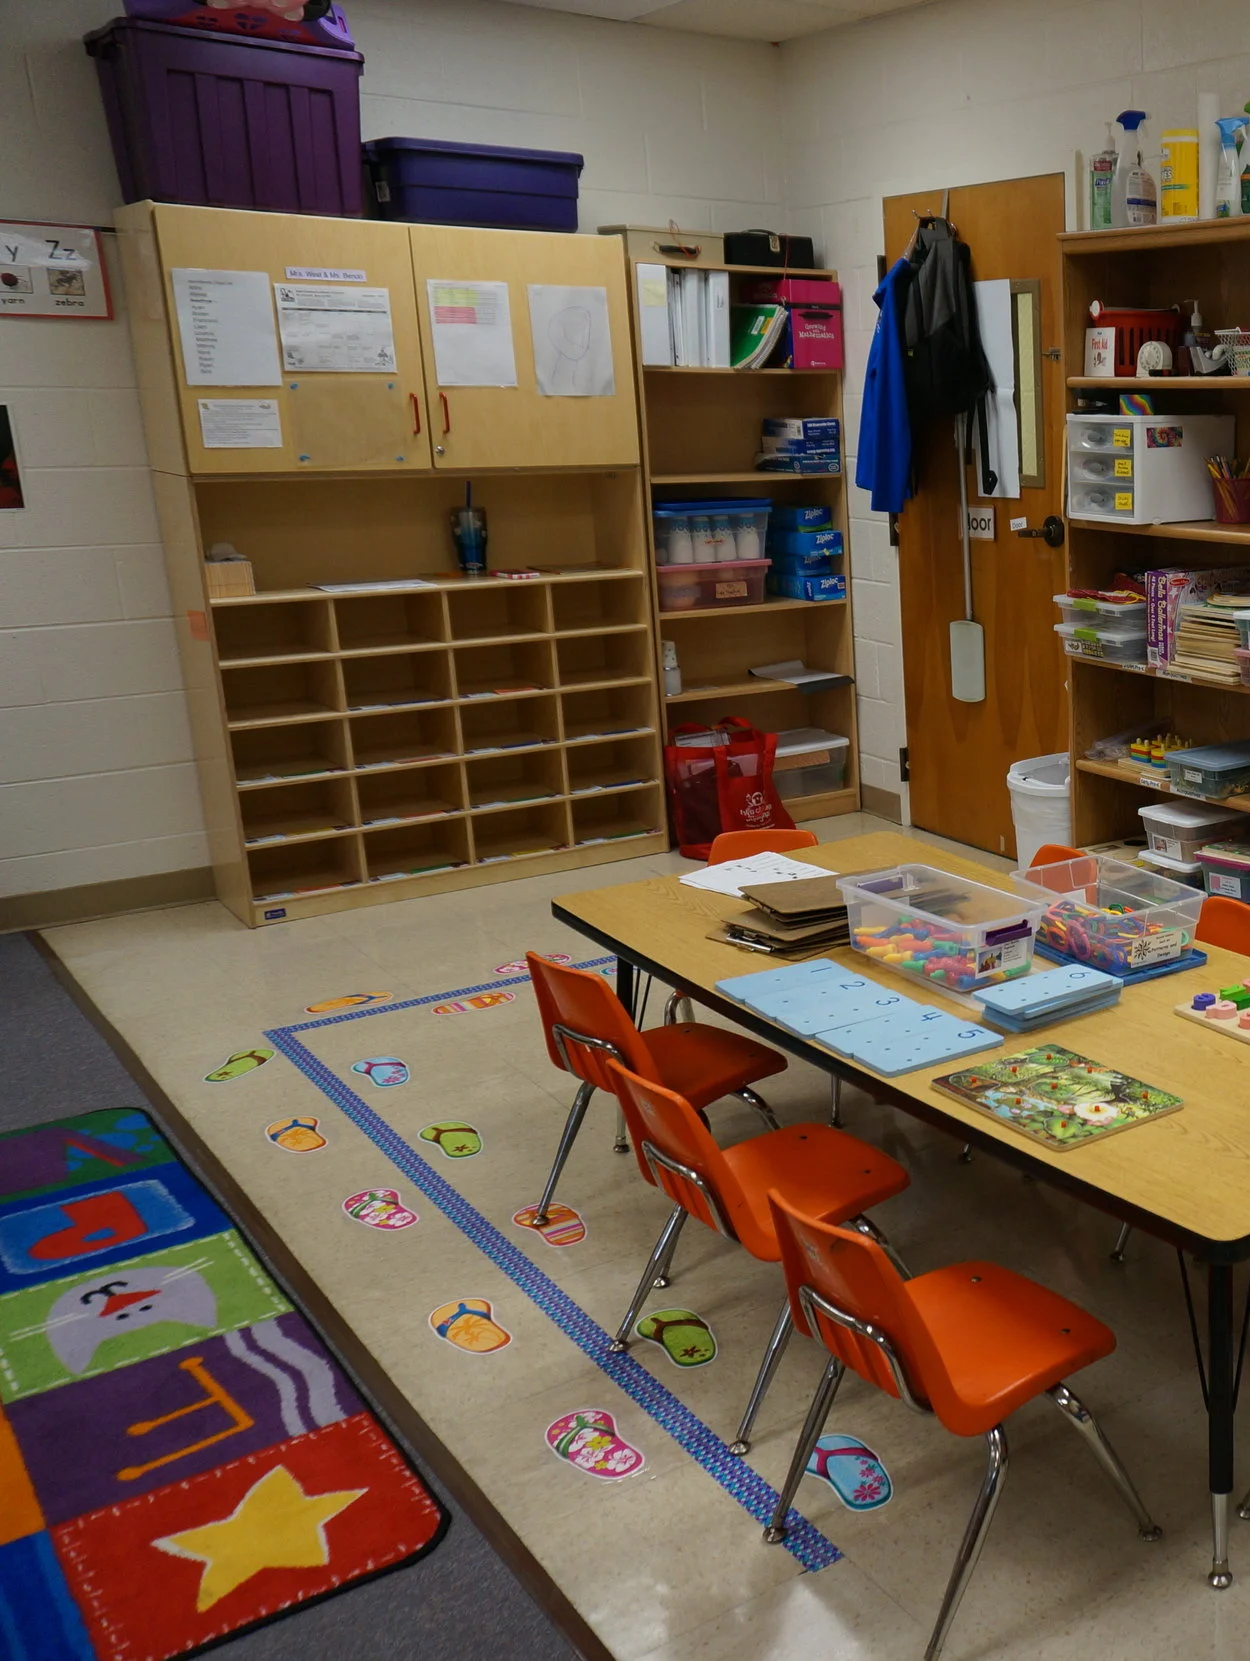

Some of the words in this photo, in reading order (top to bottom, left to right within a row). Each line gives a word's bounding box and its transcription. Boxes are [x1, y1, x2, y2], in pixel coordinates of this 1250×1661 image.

[55, 298, 84, 307] zebra
[804, 508, 823, 520] Ziploc
[816, 533, 834, 544] Ziploc
[821, 577, 838, 589] Ziploc
[1157, 576, 1166, 598] Bella
[1157, 600, 1166, 641] Ballerinas
